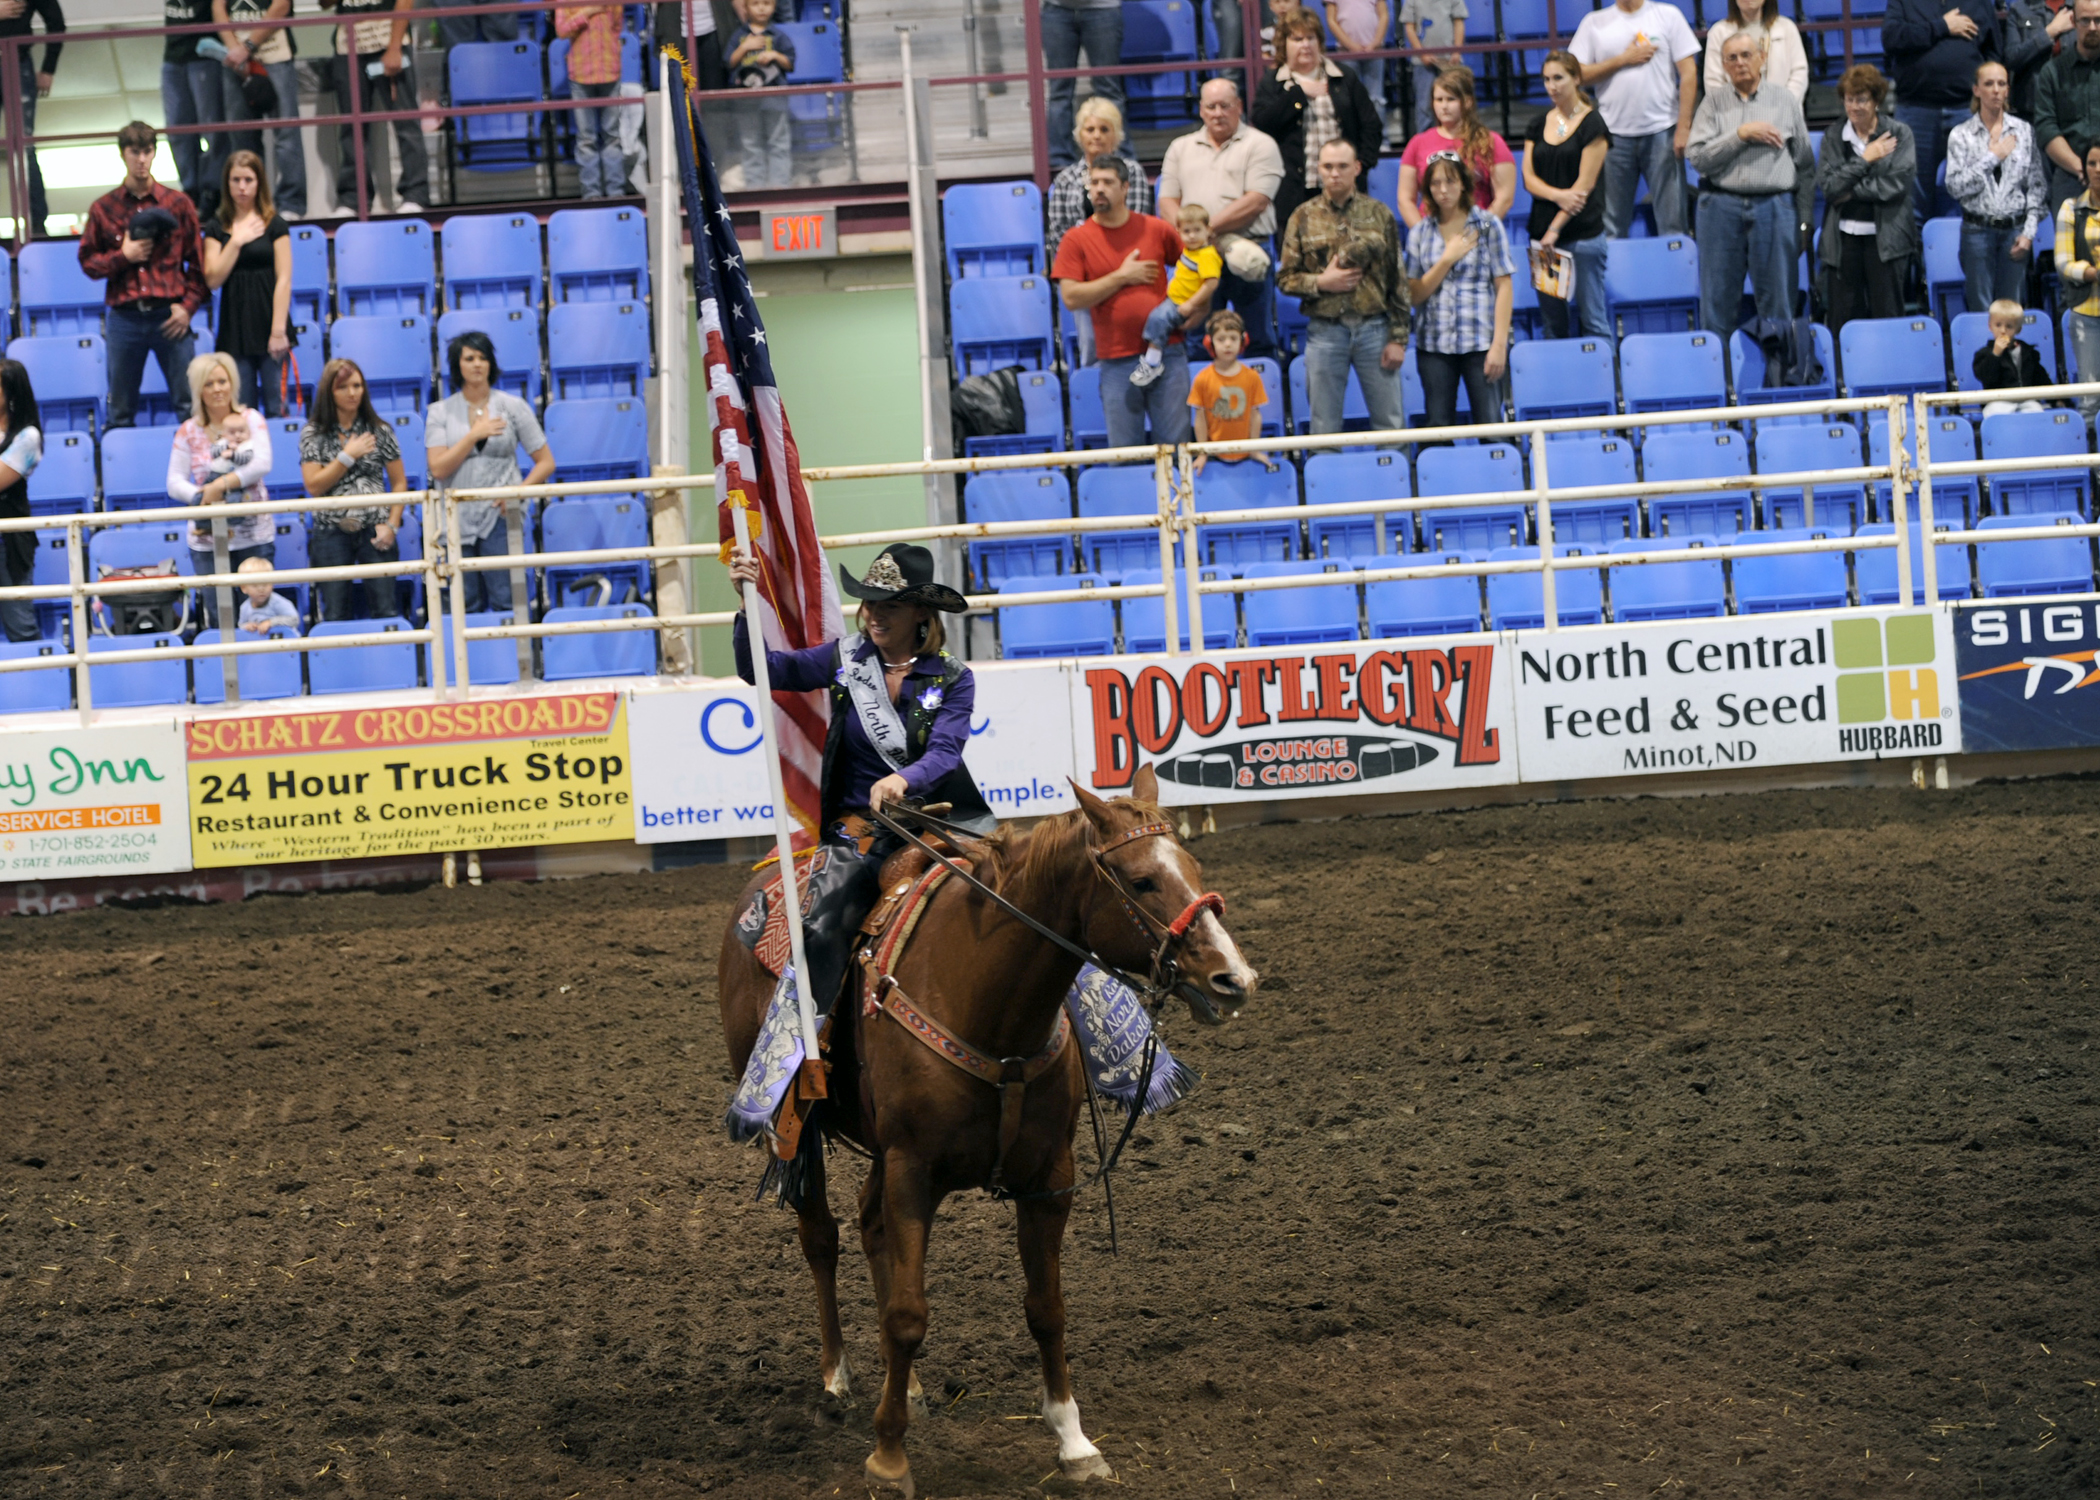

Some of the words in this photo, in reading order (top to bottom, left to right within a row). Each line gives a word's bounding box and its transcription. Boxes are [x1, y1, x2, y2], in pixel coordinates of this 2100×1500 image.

[772, 214, 824, 251] EXIT
[1971, 605, 2100, 646] SIG
[1521, 641, 1648, 685] North
[1666, 628, 1827, 674] Central
[191, 714, 345, 754] SCHATZ
[354, 695, 610, 743] CROSSROADS
[862, 698, 891, 745] North
[1085, 645, 1500, 790] BOOTLEGRZ
[1544, 697, 1651, 740] Feed
[1670, 698, 1699, 731] &
[1716, 685, 1827, 728] Seed
[530, 738, 567, 749] Travel
[569, 736, 609, 746] Center
[1242, 738, 1348, 764] LOUNGE
[1839, 723, 1943, 752] HUBBARD
[49, 746, 165, 795] Inn
[200, 773, 251, 804] 24
[268, 771, 370, 799] Hour
[384, 757, 509, 791] Truck
[526, 753, 623, 784] Stop
[1236, 766, 1255, 787] &
[1260, 760, 1358, 785] CASINO
[0, 809, 82, 832] SERVICE
[92, 806, 153, 826] HOTEL
[197, 808, 342, 834] Restaurant
[353, 806, 371, 823] &
[380, 797, 548, 820] Convenience
[559, 790, 629, 808] Store
[642, 805, 723, 827] better
[733, 805, 775, 821] wa
[980, 778, 1064, 808] imple.
[30, 832, 157, 852] 1-701-852-2504
[212, 840, 266, 851] Where
[456, 824, 486, 835] has
[493, 820, 530, 831] been
[537, 821, 548, 830] a
[552, 816, 591, 831] part
[597, 814, 615, 828] of
[255, 850, 284, 860] our
[290, 844, 359, 859] heritage
[365, 842, 392, 857] for
[397, 840, 424, 850] the
[428, 835, 465, 851] past
[472, 833, 494, 845] 30
[12, 856, 52, 869] STATE
[57, 851, 151, 867] FAIRGROUNDS
